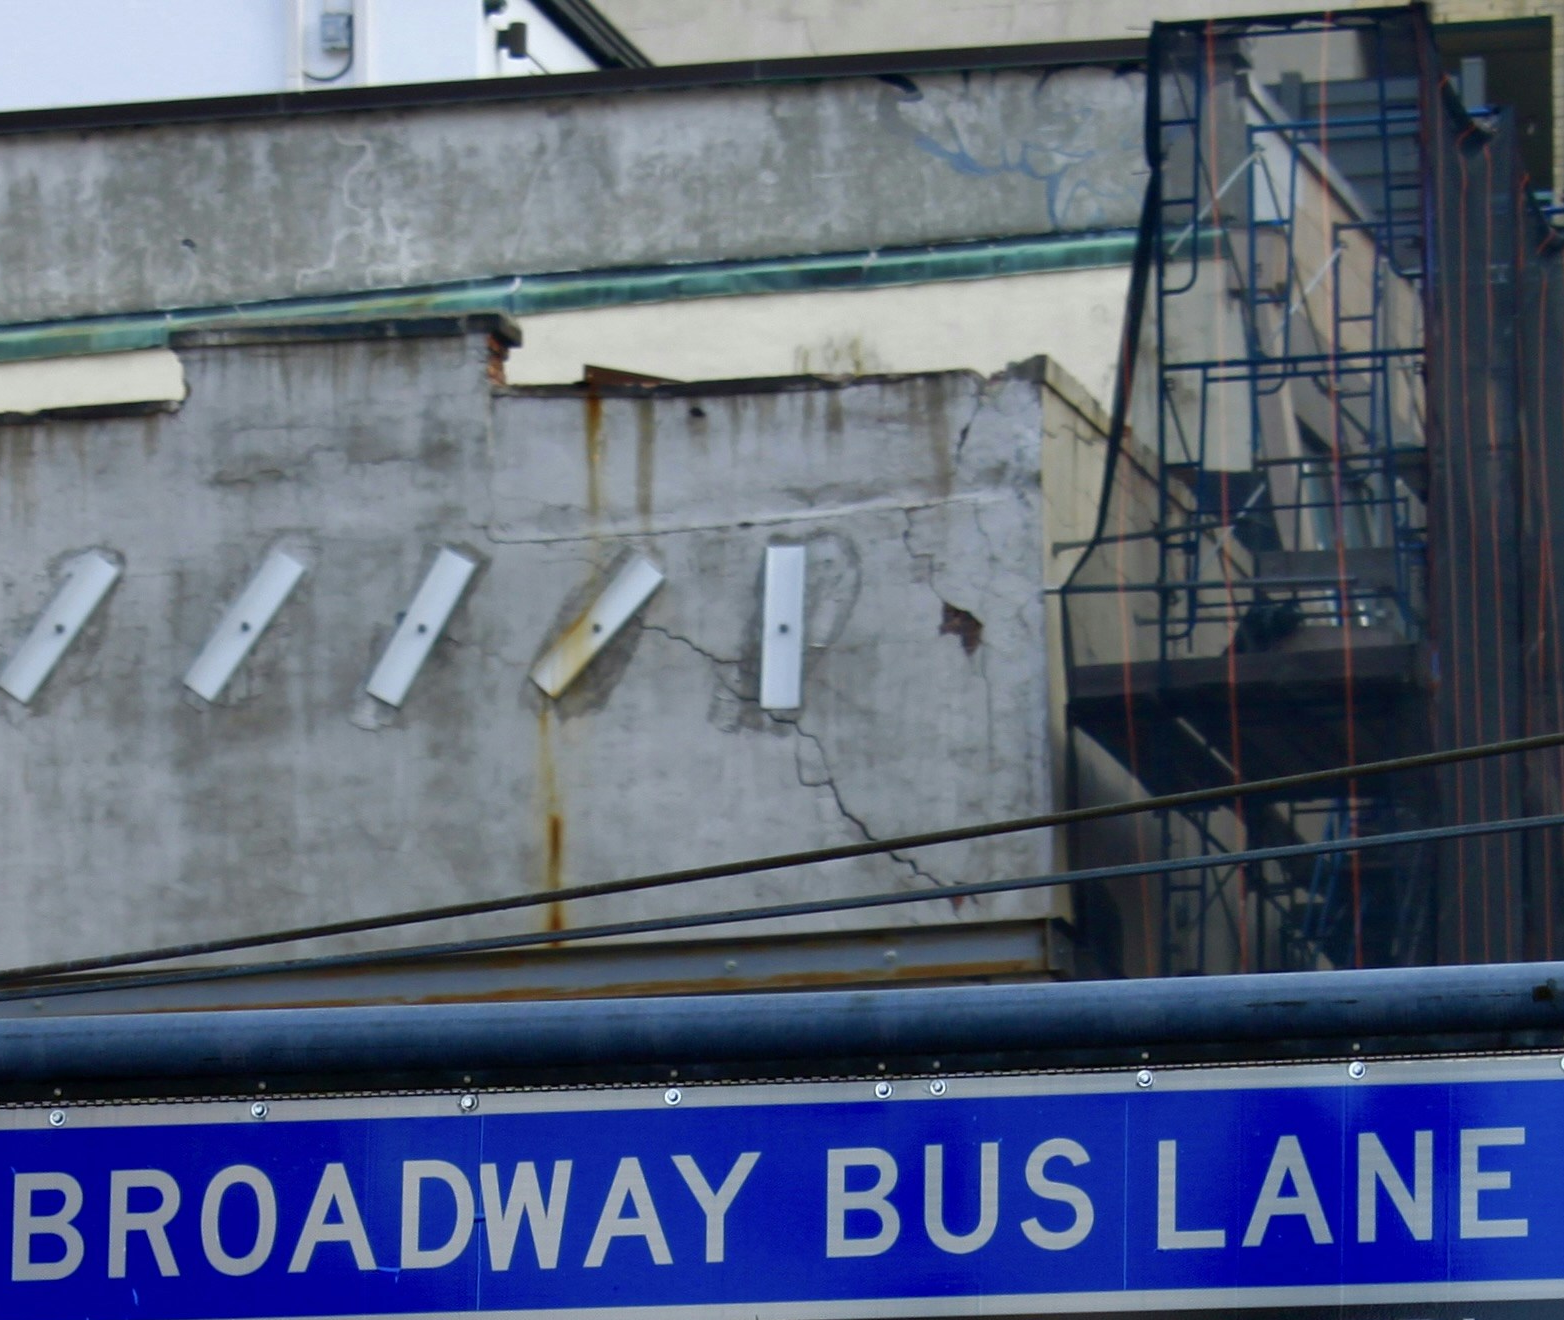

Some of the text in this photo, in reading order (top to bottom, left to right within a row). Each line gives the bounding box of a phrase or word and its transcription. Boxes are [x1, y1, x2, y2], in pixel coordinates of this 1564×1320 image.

[11, 1138, 1529, 1282] BROADWAY BUS LANE
